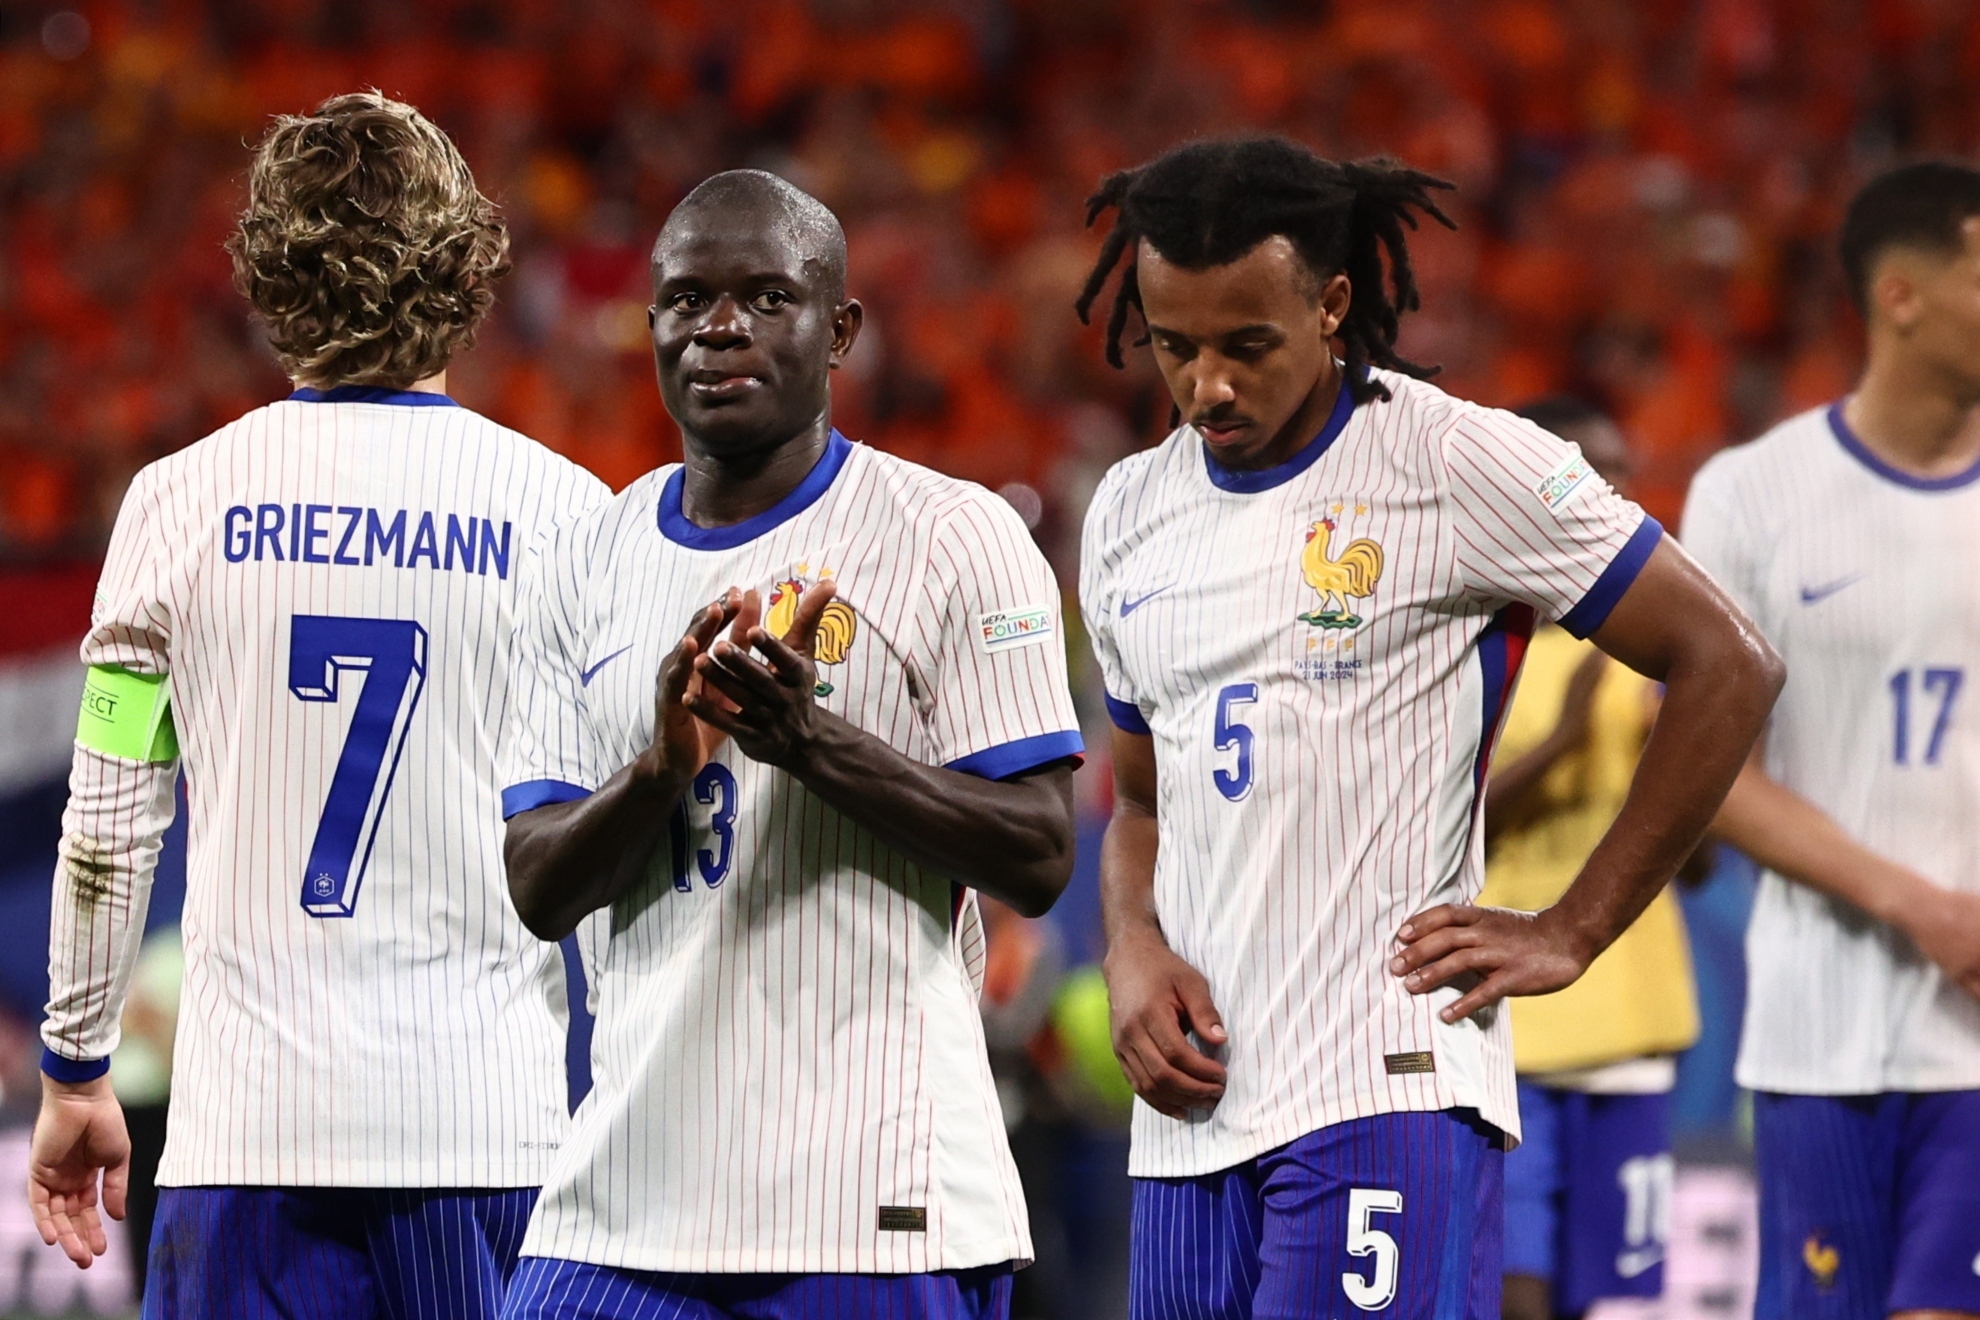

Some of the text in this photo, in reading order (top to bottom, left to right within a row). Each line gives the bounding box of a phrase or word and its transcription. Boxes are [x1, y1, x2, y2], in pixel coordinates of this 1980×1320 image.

[224, 503, 512, 580] GRIEZMANN
[982, 614, 1006, 626] UEFA
[289, 614, 428, 918] 7
[1213, 683, 1258, 802] 5
[1889, 668, 1964, 767] 17
[670, 763, 738, 892] 13
[1342, 1188, 1403, 1311] 5
